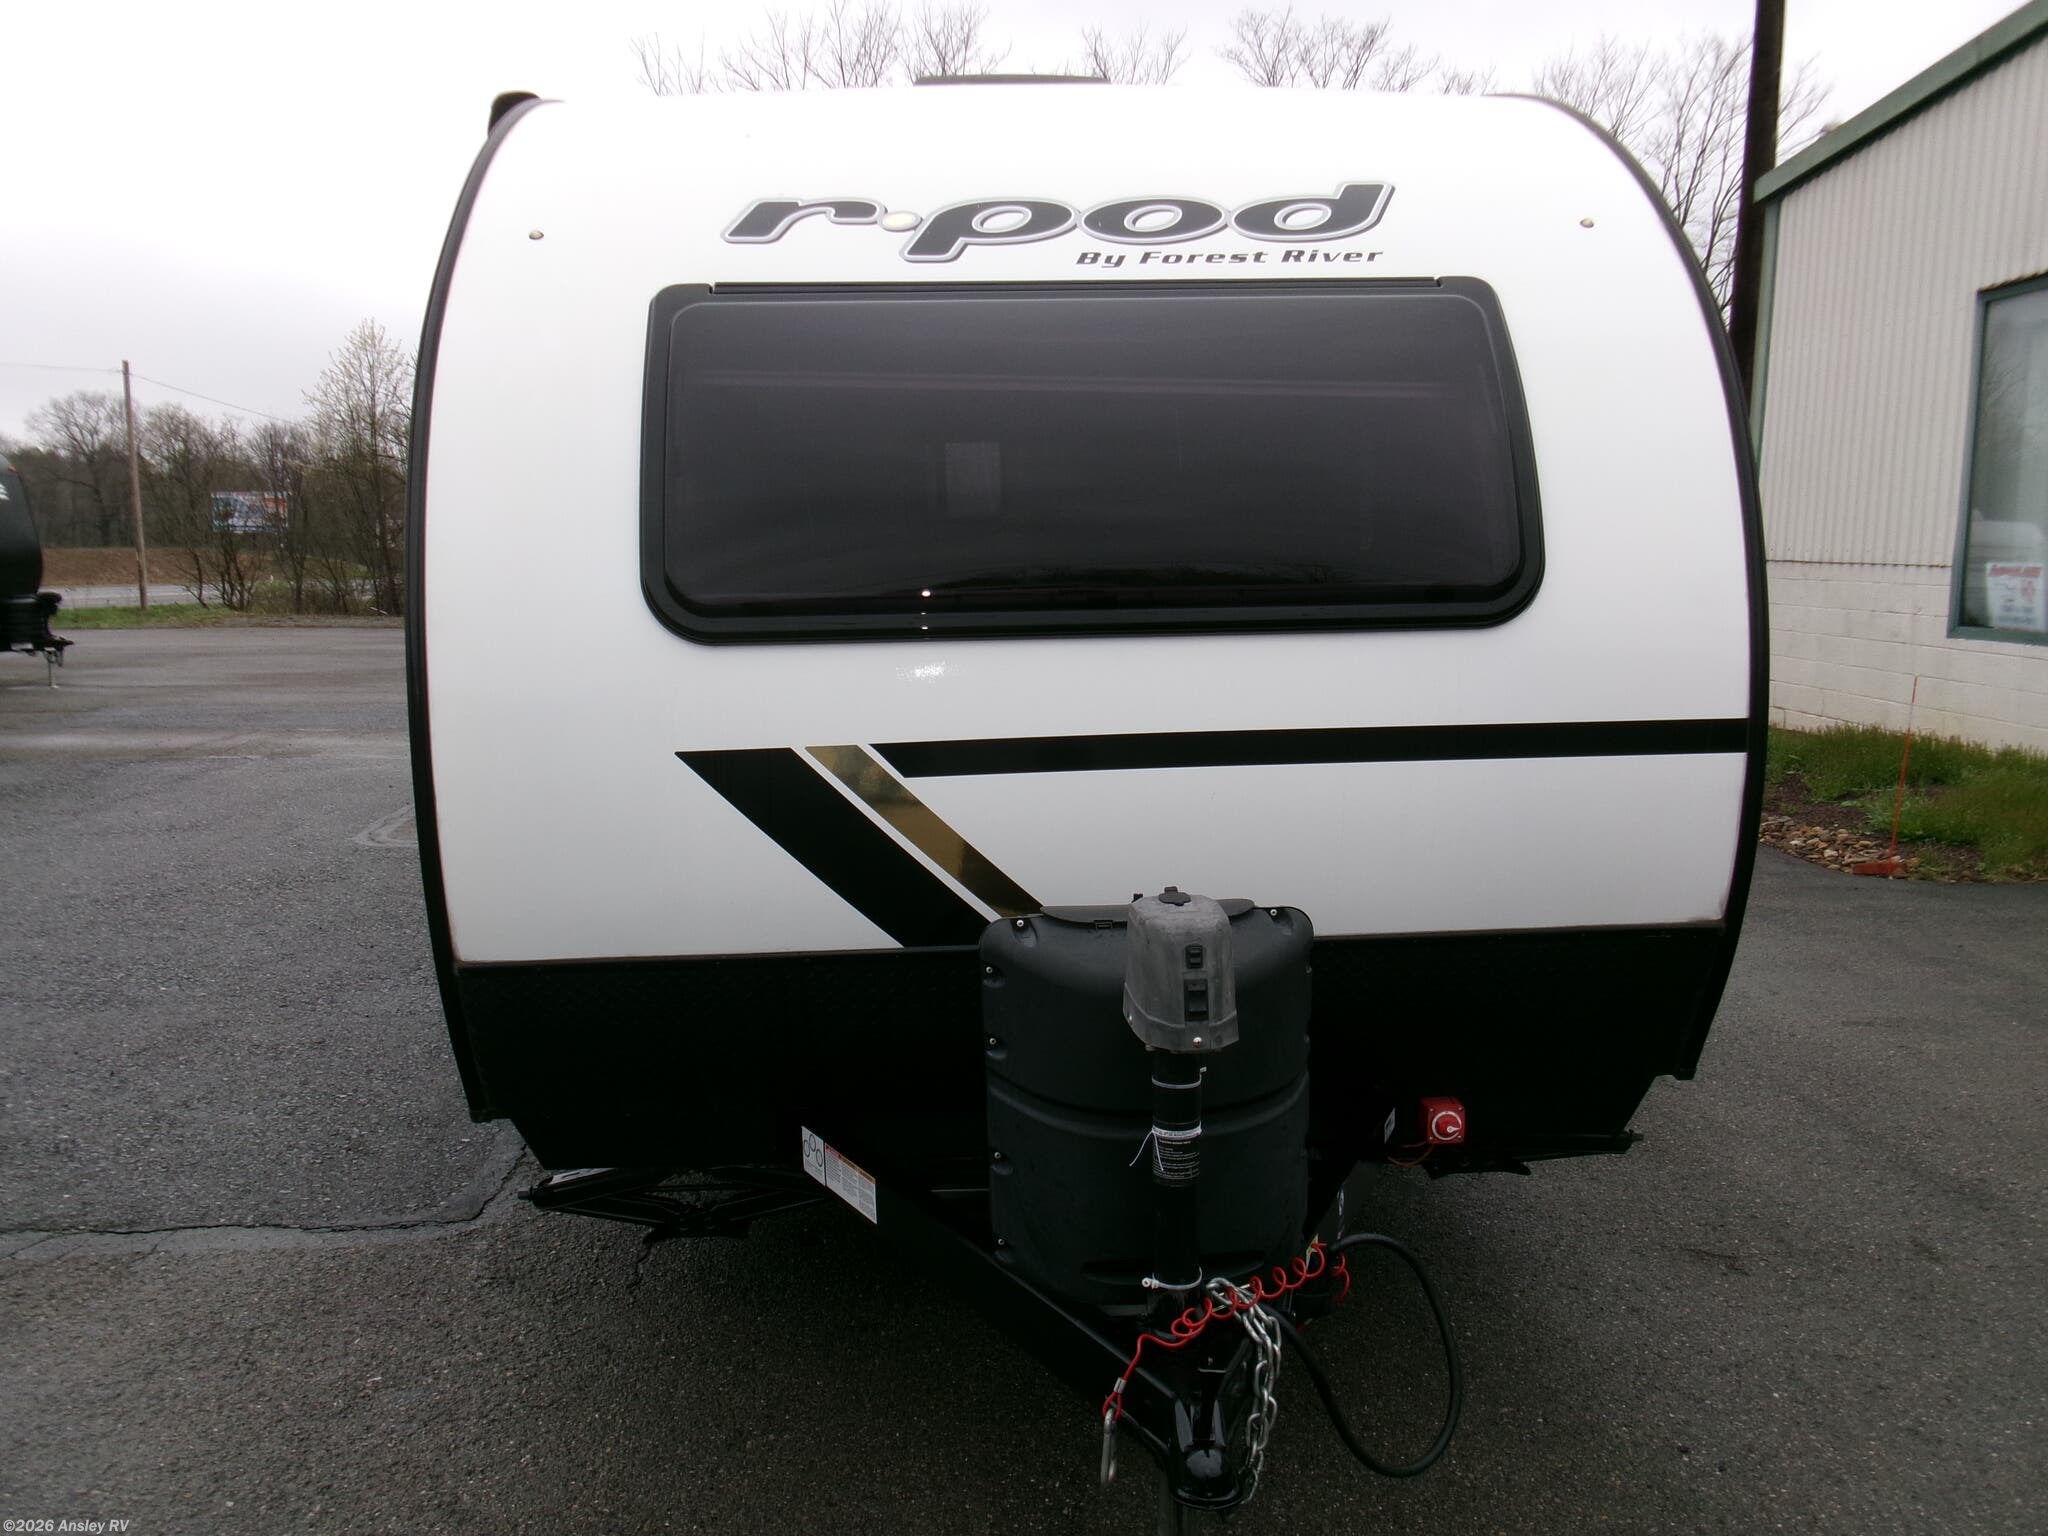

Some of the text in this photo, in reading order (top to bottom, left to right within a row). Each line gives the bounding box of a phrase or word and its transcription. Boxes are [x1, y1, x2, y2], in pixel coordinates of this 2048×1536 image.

[1077, 248, 1384, 268] By Forest River
